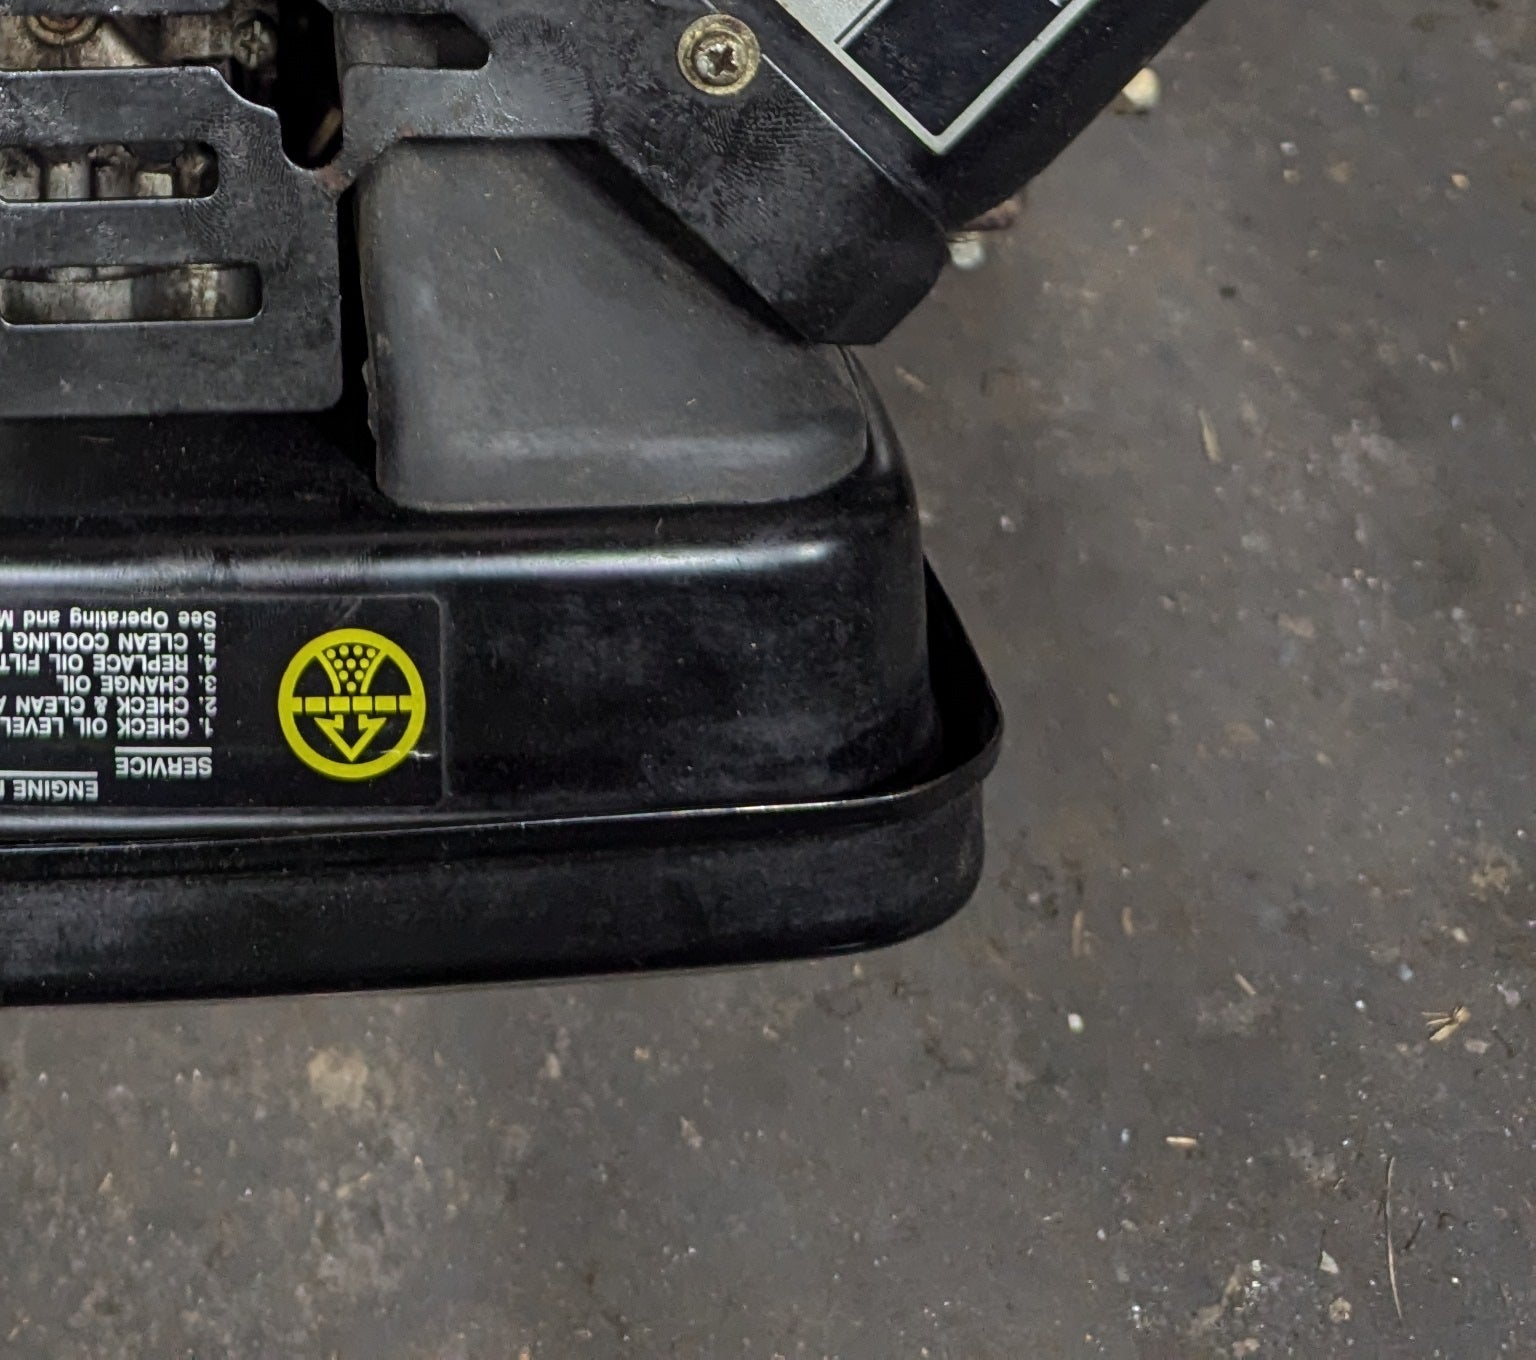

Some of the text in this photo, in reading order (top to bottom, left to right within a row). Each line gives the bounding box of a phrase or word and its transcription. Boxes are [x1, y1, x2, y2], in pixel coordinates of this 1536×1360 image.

[24, 609, 60, 630] and
[70, 607, 168, 630] Operating
[178, 611, 216, 630] See
[13, 632, 109, 652] COOLING
[118, 632, 188, 652] CLEAN
[198, 632, 216, 652] 5.
[49, 654, 83, 673] OIL
[93, 654, 188, 673] REPLACE
[198, 654, 216, 673] 4.
[56, 675, 216, 695] 3. CHANGE OIL
[15, 695, 85, 716] CLEAN
[94, 696, 108, 715] &
[116, 696, 189, 716] CHECK
[199, 696, 216, 716] 2.
[0, 716, 214, 738] 1. CHECK OIL LEVEL
[114, 756, 212, 779] SERVICE
[13, 779, 98, 801] ENGINE
